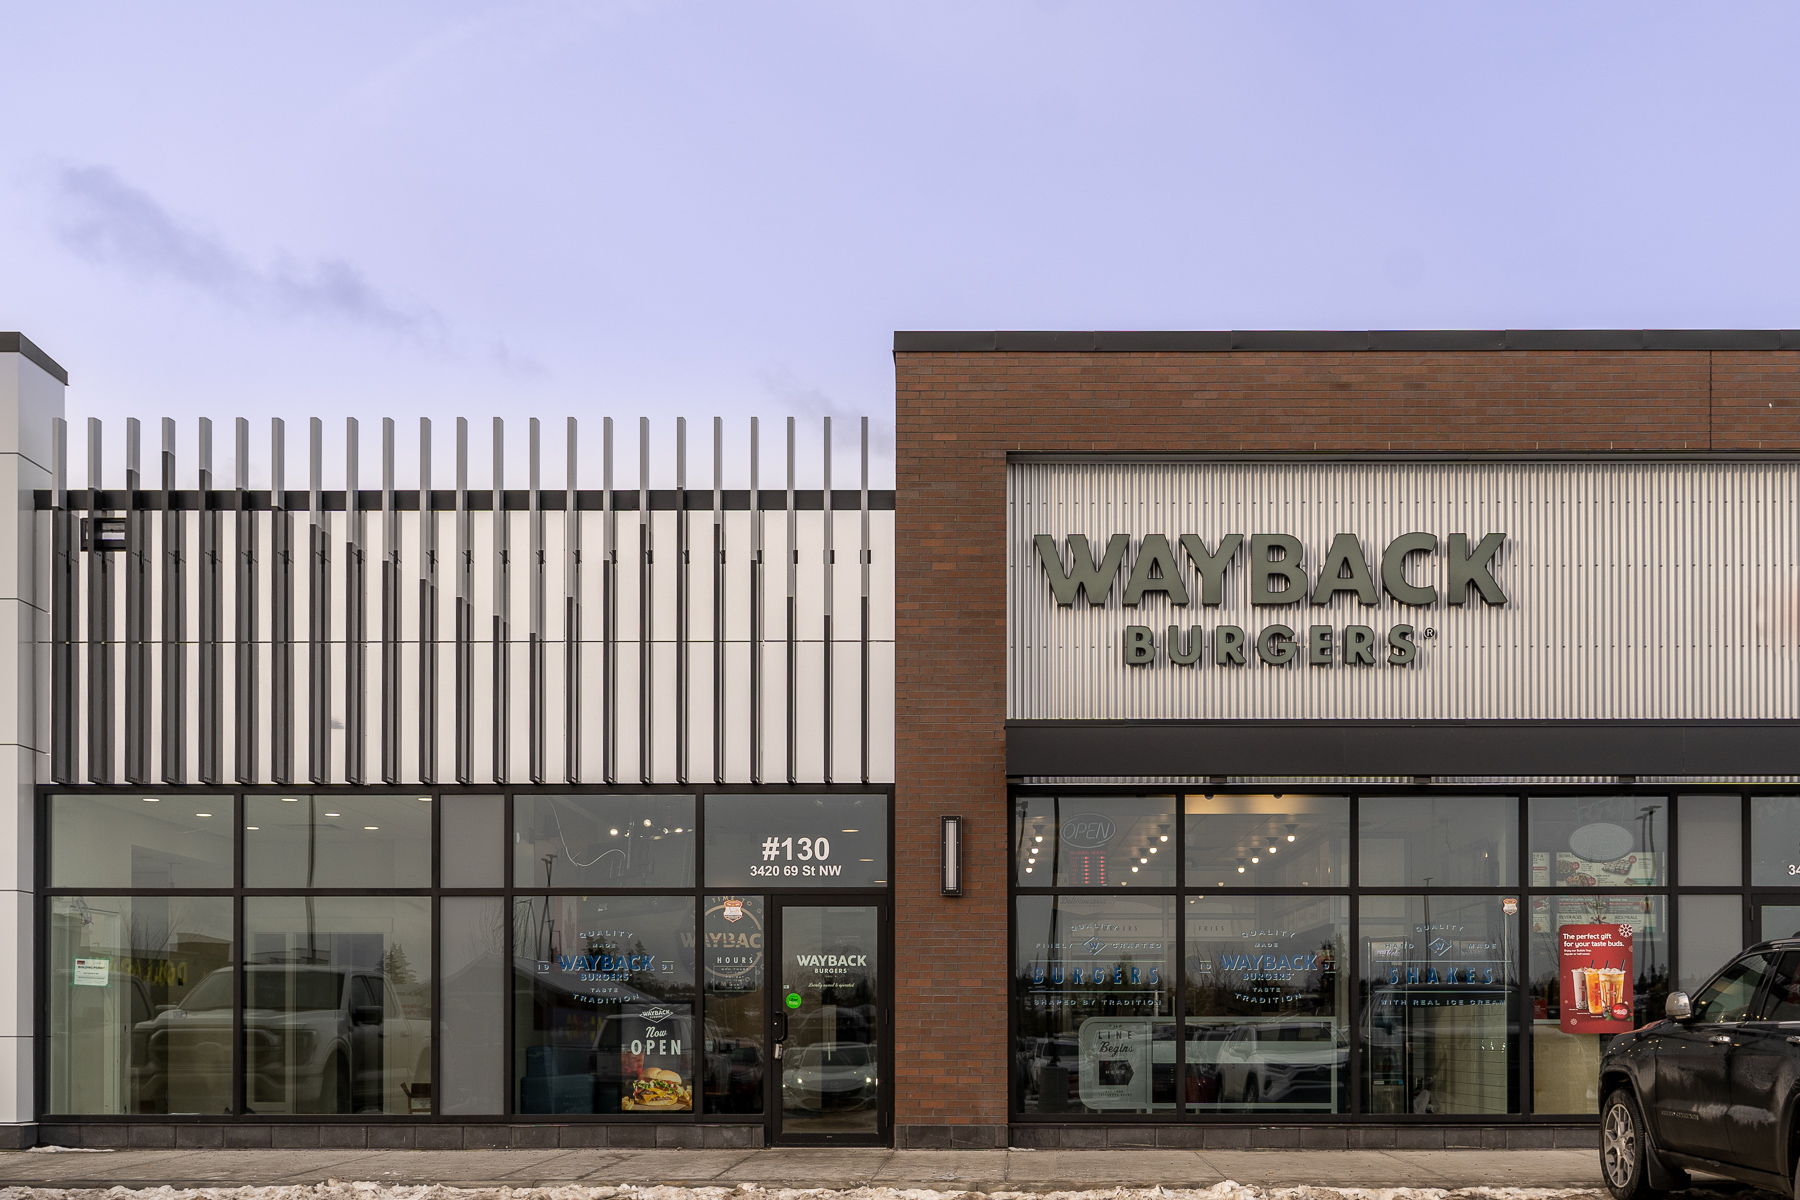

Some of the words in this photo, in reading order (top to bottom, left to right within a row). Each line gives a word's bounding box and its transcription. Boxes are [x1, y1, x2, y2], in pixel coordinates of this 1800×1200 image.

[1033, 532, 1509, 606] WAYBACK
[1063, 822, 1111, 840] OPEN
[761, 836, 830, 861] #130
[749, 865, 780, 877] 3420
[783, 865, 799, 877] 69
[802, 865, 816, 877] St
[819, 865, 842, 876] NW
[580, 930, 634, 939] QUALITY
[1240, 929, 1296, 939] QUALITY
[1416, 924, 1464, 933] QUALITY
[1575, 941, 1591, 949] your
[556, 954, 656, 972] WAYBACK
[716, 956, 754, 964] HOURS
[796, 954, 867, 967] WAYBACK
[1219, 954, 1318, 971] WAYBACK
[1033, 966, 1159, 985] BURGERS
[1390, 967, 1493, 985] SHAKES
[573, 993, 640, 1004] TRADITION
[1235, 993, 1302, 1004] TRADITION
[641, 1009, 671, 1017] WAYBACK
[645, 1025, 669, 1039] Now
[1098, 1030, 1132, 1040] LINE
[630, 1039, 682, 1056] OPEN
[1099, 1041, 1135, 1057] Begins
